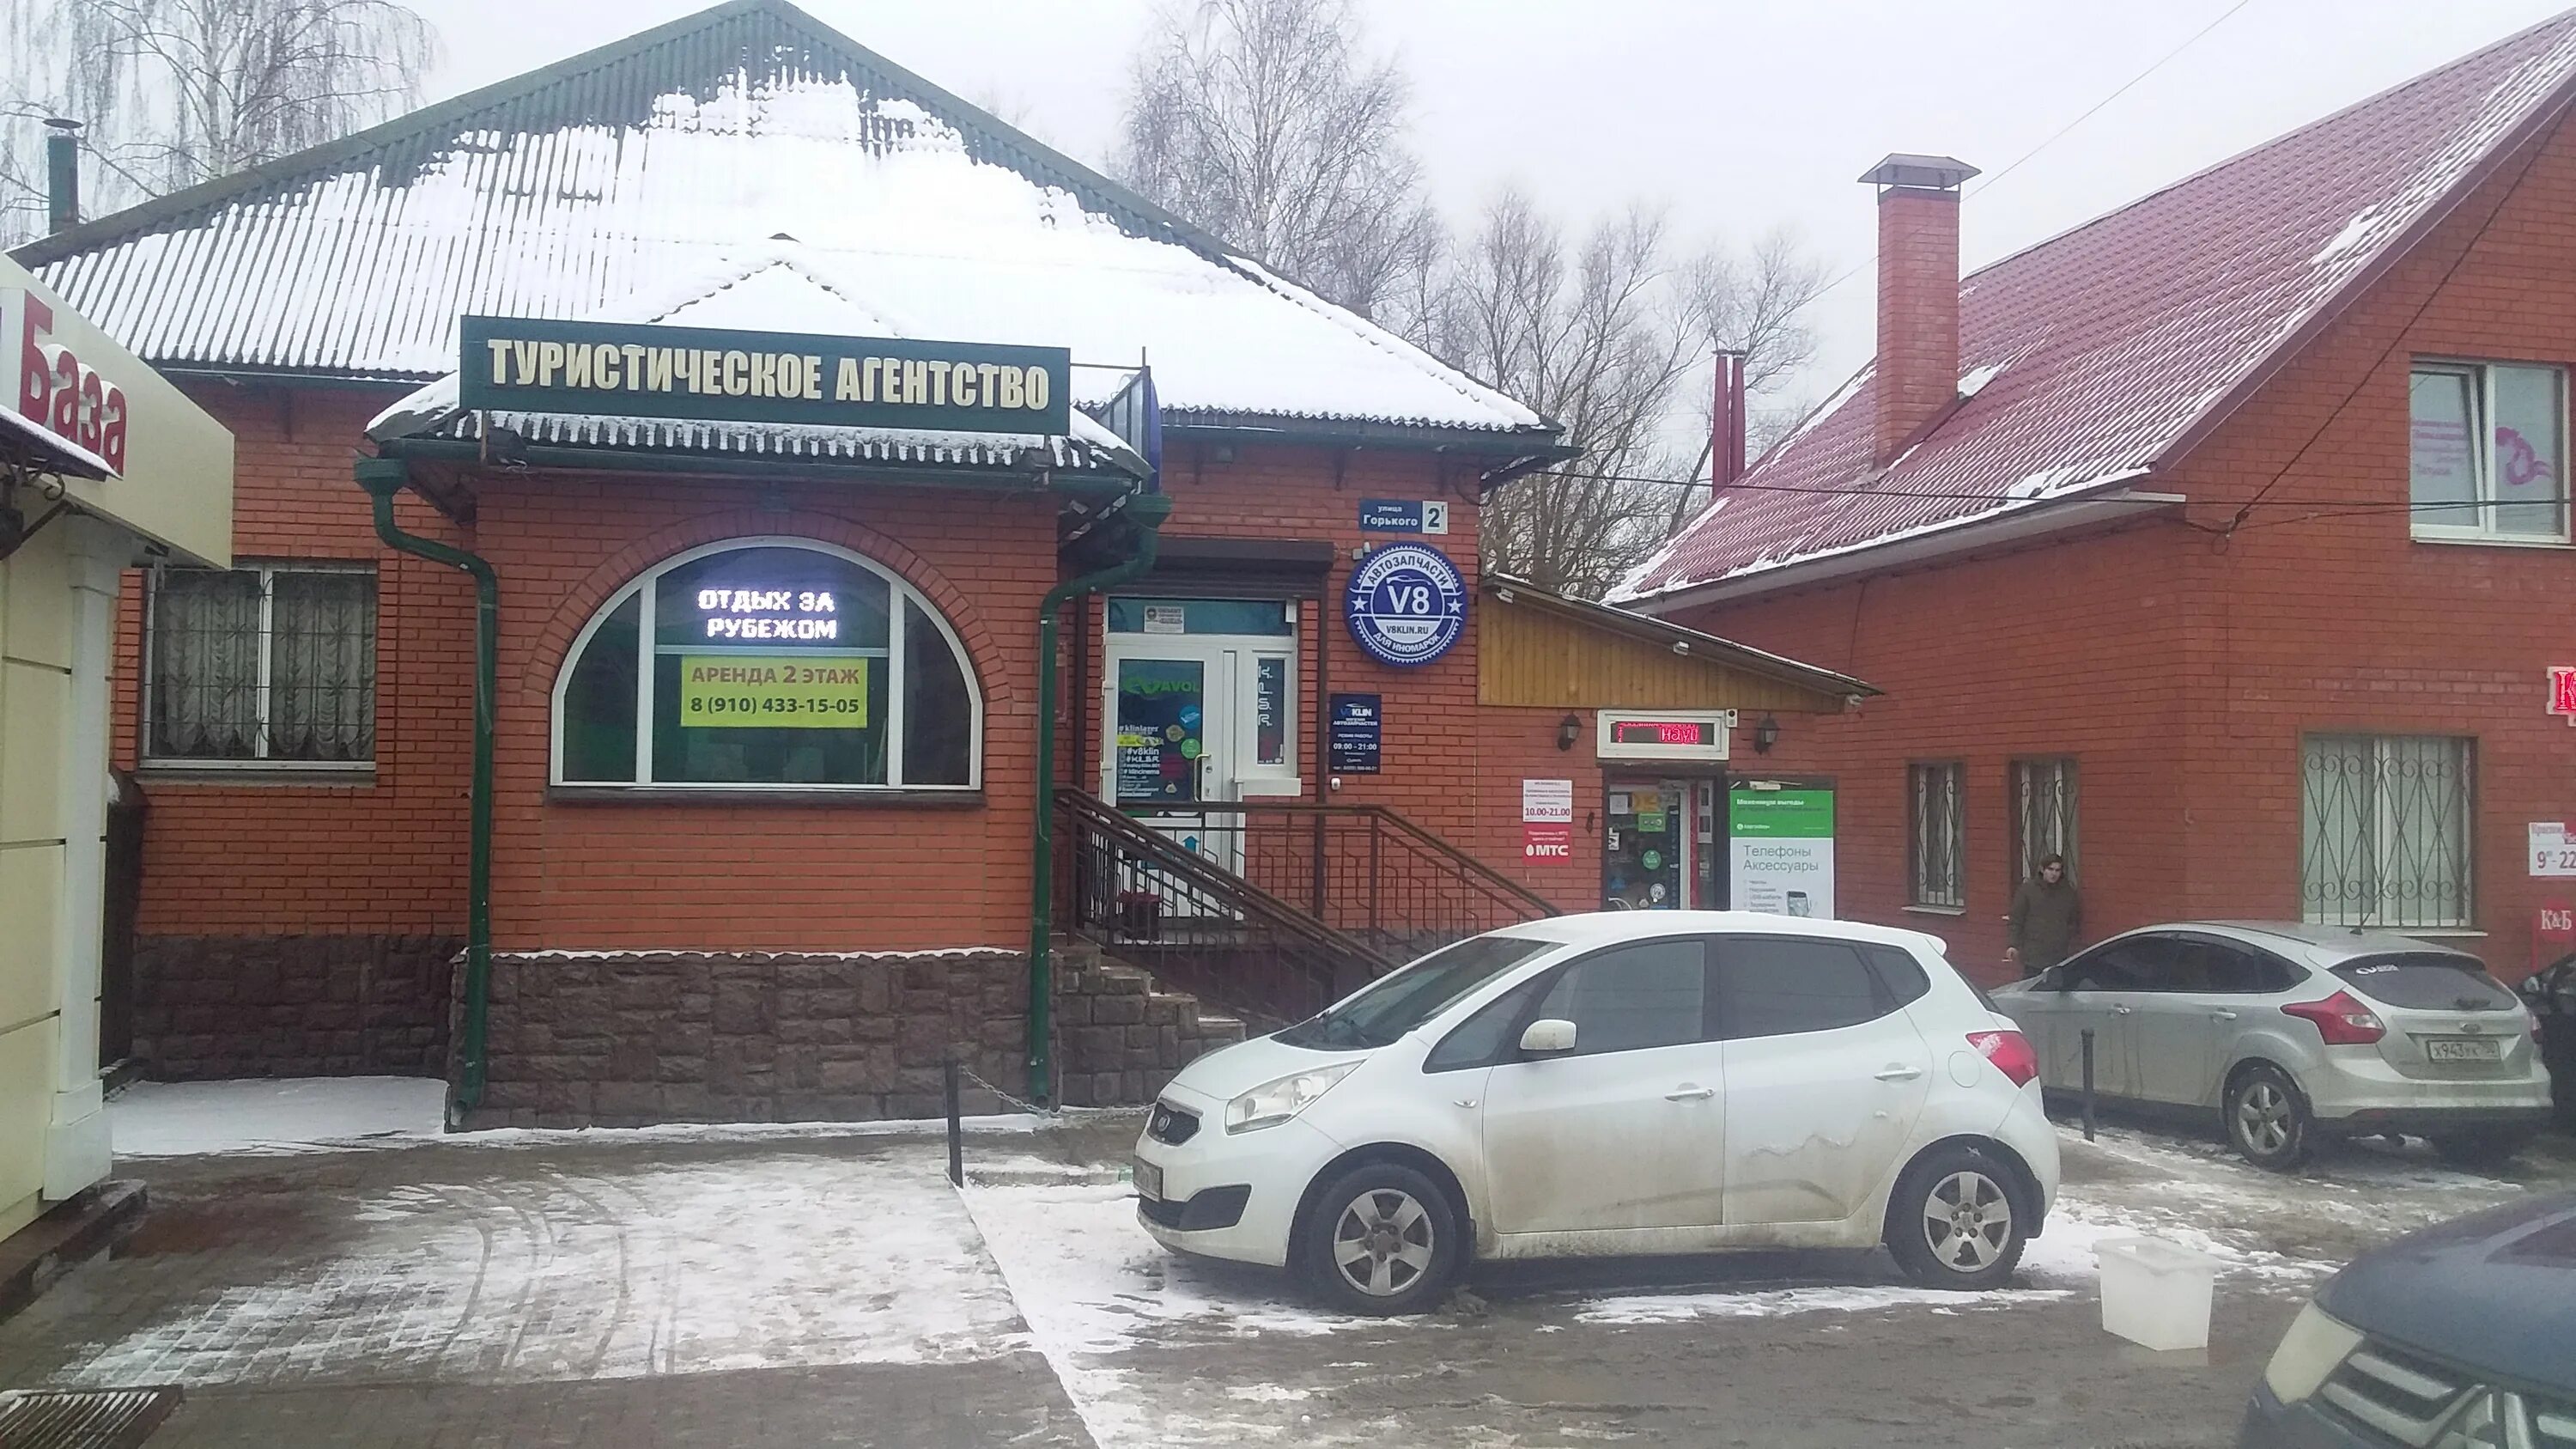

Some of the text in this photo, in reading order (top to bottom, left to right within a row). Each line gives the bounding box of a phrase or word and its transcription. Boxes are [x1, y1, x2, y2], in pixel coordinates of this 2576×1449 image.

[19, 289, 126, 476] База
[488, 338, 1049, 411] ТУРИСТИЧЕСКОЕ АГЕНТСТВО
[1377, 504, 1402, 513] улица
[1363, 514, 1418, 527] Горького
[1367, 555, 1449, 586] АВТОЗАПЧАСТИ
[697, 589, 835, 613] ОТДЫХ ЗА
[1387, 585, 1430, 614] V8
[707, 618, 838, 639] РУБЕЖОМ
[1386, 625, 1429, 634] V8KLIN.RU
[1373, 632, 1442, 653] ДЛЯ ИНОМАРОК
[691, 666, 860, 686] АРЕНДА 2 ЭТАЖ
[690, 697, 860, 715] 8 (910) 433-15-05
[1525, 807, 1571, 816] 10.00-21.00
[1535, 844, 1569, 855] МТС
[1744, 844, 1812, 859] Телефоны
[1743, 859, 1819, 874] Аксессуары
[2541, 910, 2573, 930] К&Б
